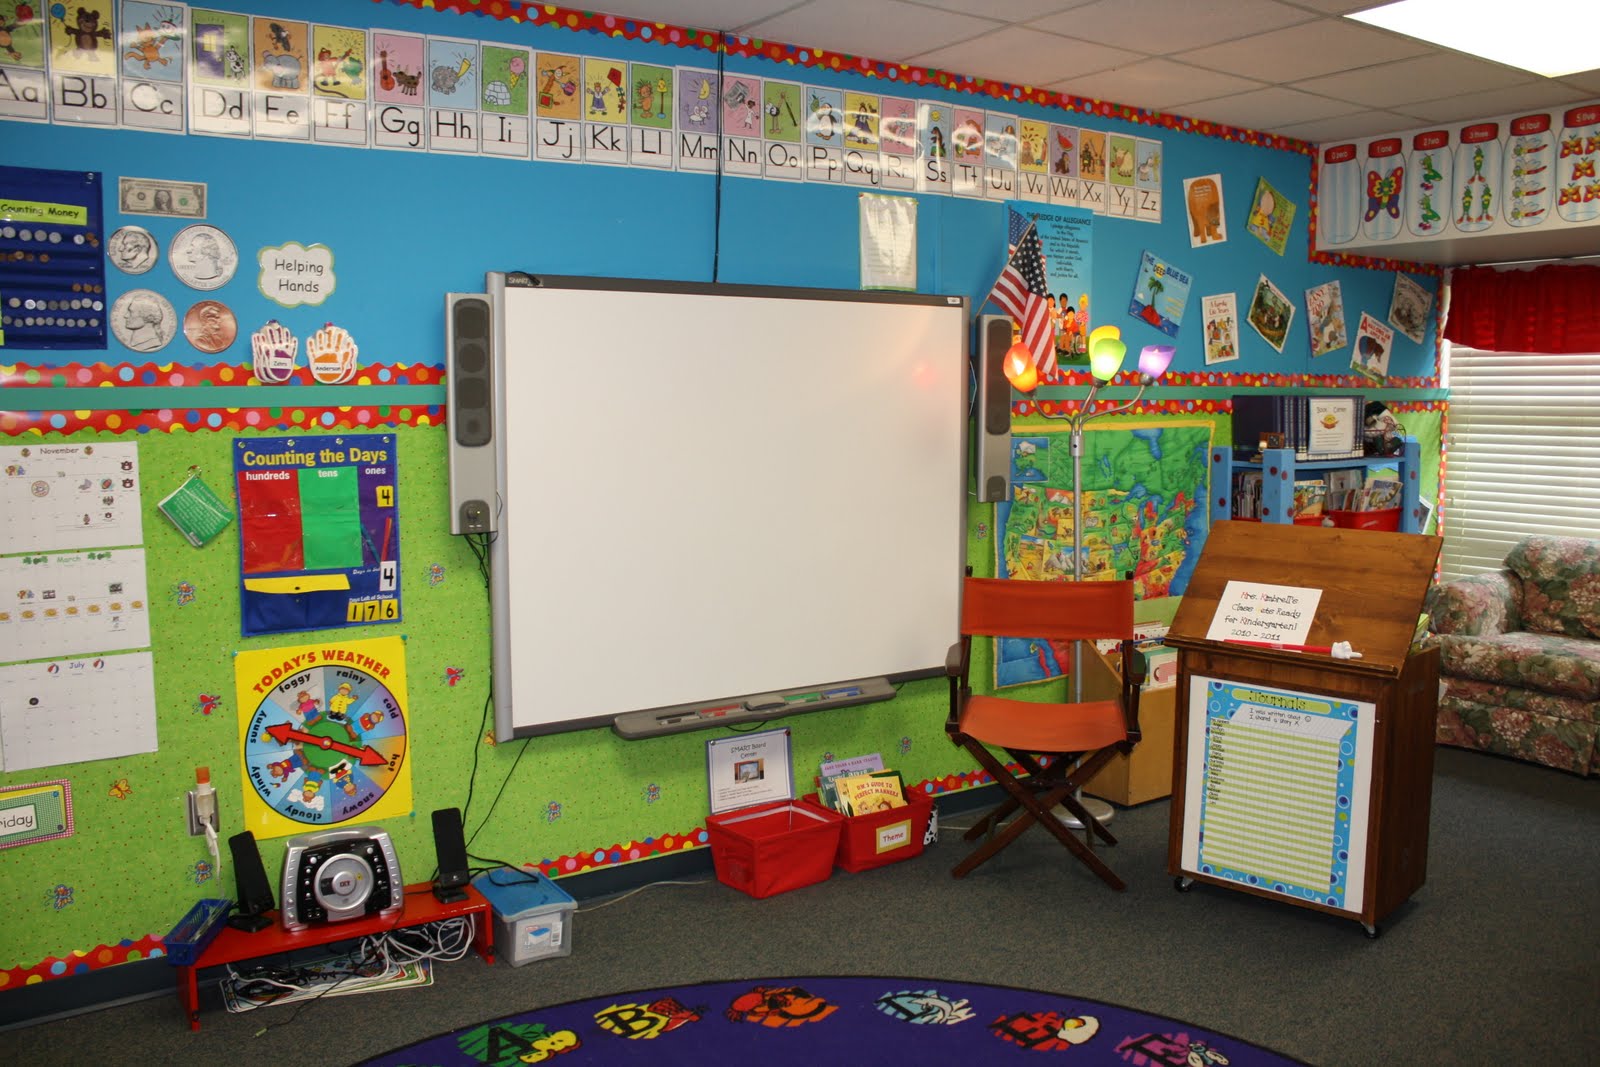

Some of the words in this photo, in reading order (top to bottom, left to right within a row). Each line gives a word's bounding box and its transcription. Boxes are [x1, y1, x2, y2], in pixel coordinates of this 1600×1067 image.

[62, 77, 107, 109] Bb
[130, 83, 173, 115] Cc
[203, 89, 243, 120] Dd
[265, 95, 300, 125] Ee
[325, 101, 356, 129] Ff
[380, 107, 420, 147] Gg
[436, 110, 471, 139] Hh
[498, 116, 512, 143] Ii
[543, 121, 573, 158] Jj
[592, 125, 621, 151] Kk
[641, 129, 662, 154] Ll
[682, 134, 718, 160] Mm
[729, 138, 757, 163] Nn
[768, 144, 798, 167] Oo
[813, 147, 837, 180] Pp
[847, 151, 878, 184] Qq
[926, 160, 946, 182] Ss
[959, 165, 977, 183] Tt
[991, 169, 1011, 191] Uu
[1026, 174, 1043, 194] Vv
[1051, 177, 1077, 198] Ww
[1083, 182, 1101, 202] Xx
[1115, 187, 1130, 214] Yy
[1141, 191, 1156, 211] Zz
[1, 203, 43, 216] Counting
[48, 207, 80, 218] Money
[274, 258, 324, 276] Helping
[1166, 267, 1180, 280] BLUE
[1179, 274, 1189, 285] SEA
[279, 279, 319, 293] Hands
[40, 447, 79, 455] November
[243, 450, 316, 467] Counting
[320, 449, 345, 463] the
[350, 448, 388, 465] Days
[246, 471, 290, 481] hundreds
[365, 467, 386, 475] ones
[381, 489, 391, 505] 4
[383, 568, 394, 587] 4
[1231, 629, 1251, 637] 2010
[1261, 633, 1281, 641] 2011
[69, 661, 85, 670] July
[253, 652, 316, 694] TODAY'S
[321, 650, 391, 680] WEATHER
[278, 673, 311, 693] foggy
[336, 670, 366, 684] rainy
[382, 698, 399, 719] cold
[1249, 690, 1306, 710] Journals
[250, 709, 267, 744] sunny
[730, 744, 751, 753] SMART
[751, 742, 767, 750] Board
[387, 753, 400, 772] hot
[251, 765, 271, 797] windy
[342, 791, 375, 816] snowy
[854, 788, 874, 801] PERFECT
[875, 789, 899, 798] MANNERS
[285, 804, 322, 822] cloudy
[882, 831, 904, 843] Theme
[608, 1007, 660, 1038] B
